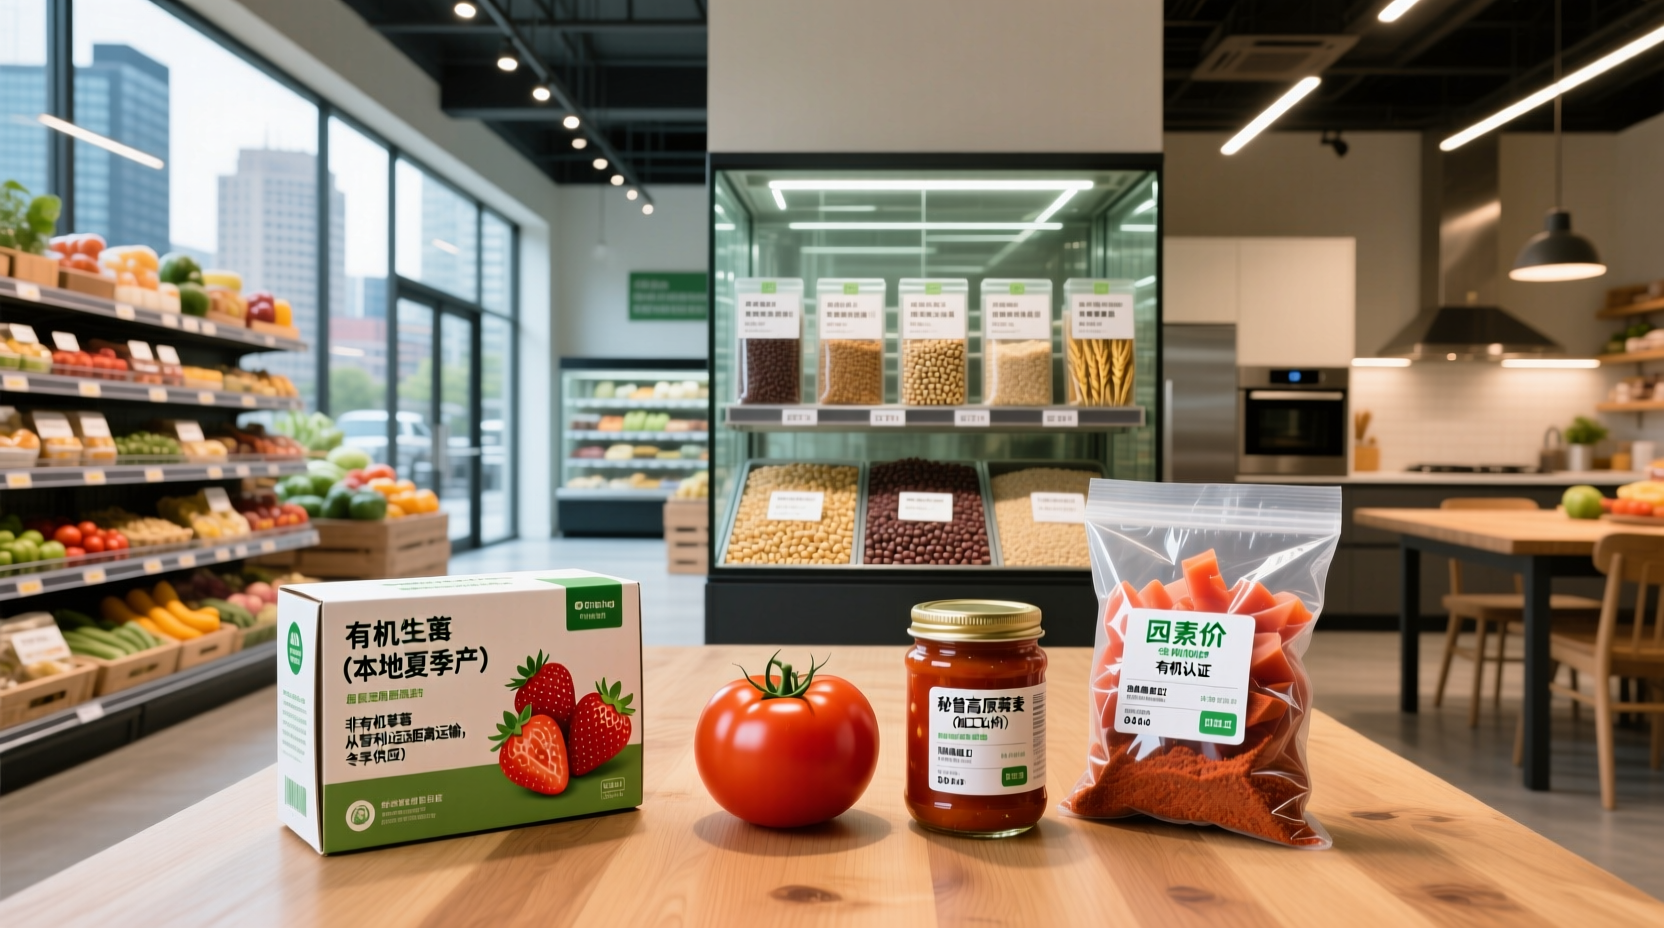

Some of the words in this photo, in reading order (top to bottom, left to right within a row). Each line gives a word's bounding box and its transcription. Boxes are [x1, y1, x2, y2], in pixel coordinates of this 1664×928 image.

[343, 646, 488, 684] (本地夏季产)
[1155, 660, 1212, 678] 有机认证
